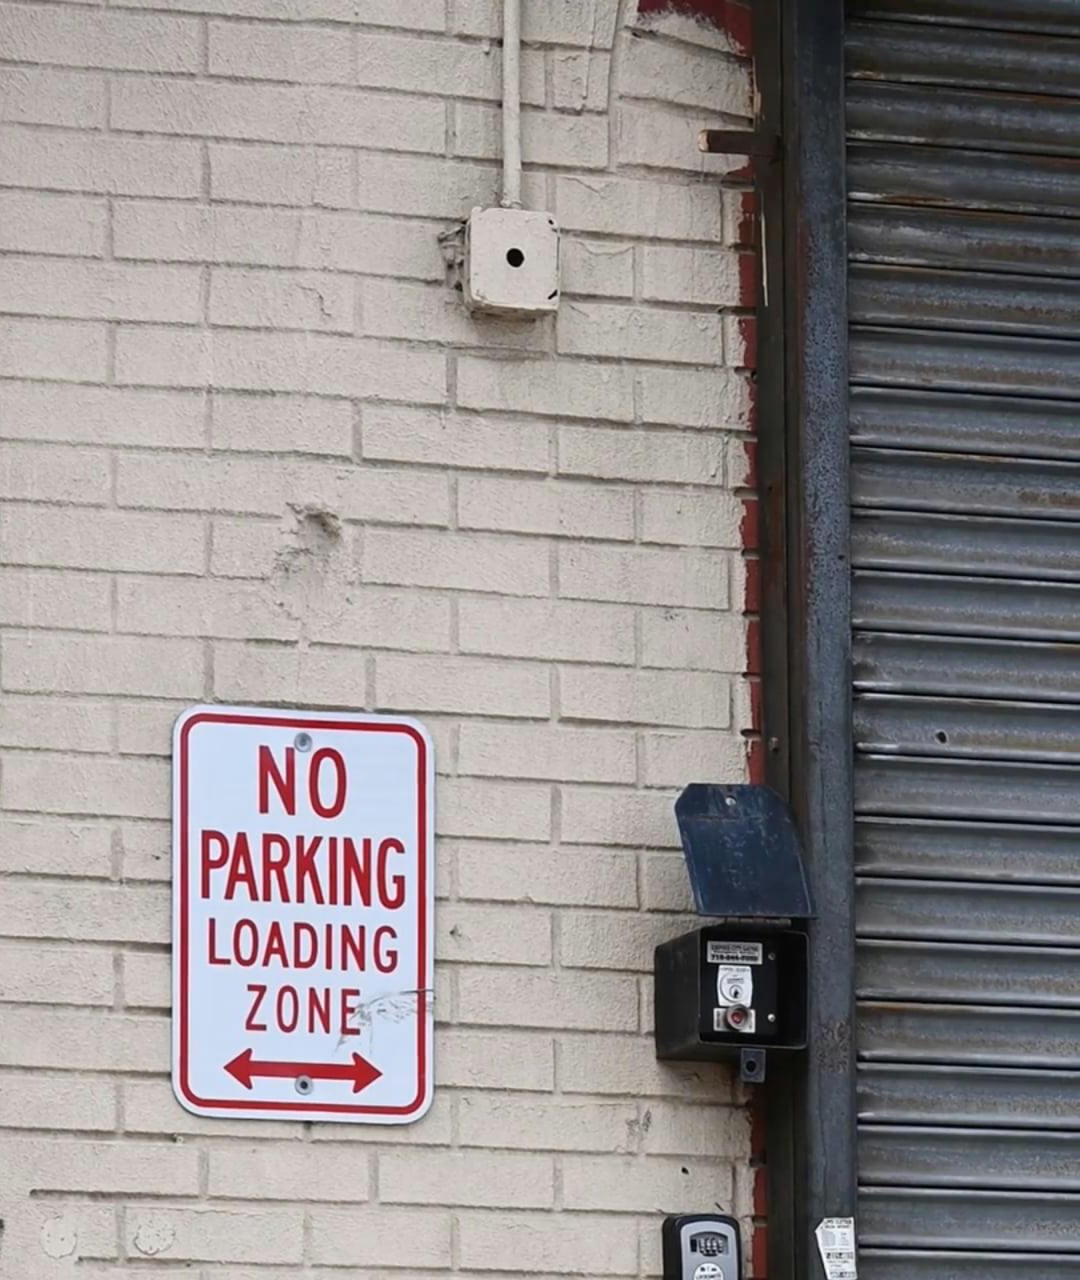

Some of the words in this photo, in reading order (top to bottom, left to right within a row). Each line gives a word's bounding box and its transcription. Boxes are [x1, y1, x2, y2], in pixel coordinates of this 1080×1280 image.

[258, 745, 348, 819] NO
[200, 829, 406, 910] PARKING
[208, 917, 399, 974] LOADING
[244, 984, 361, 1036] ZONE
